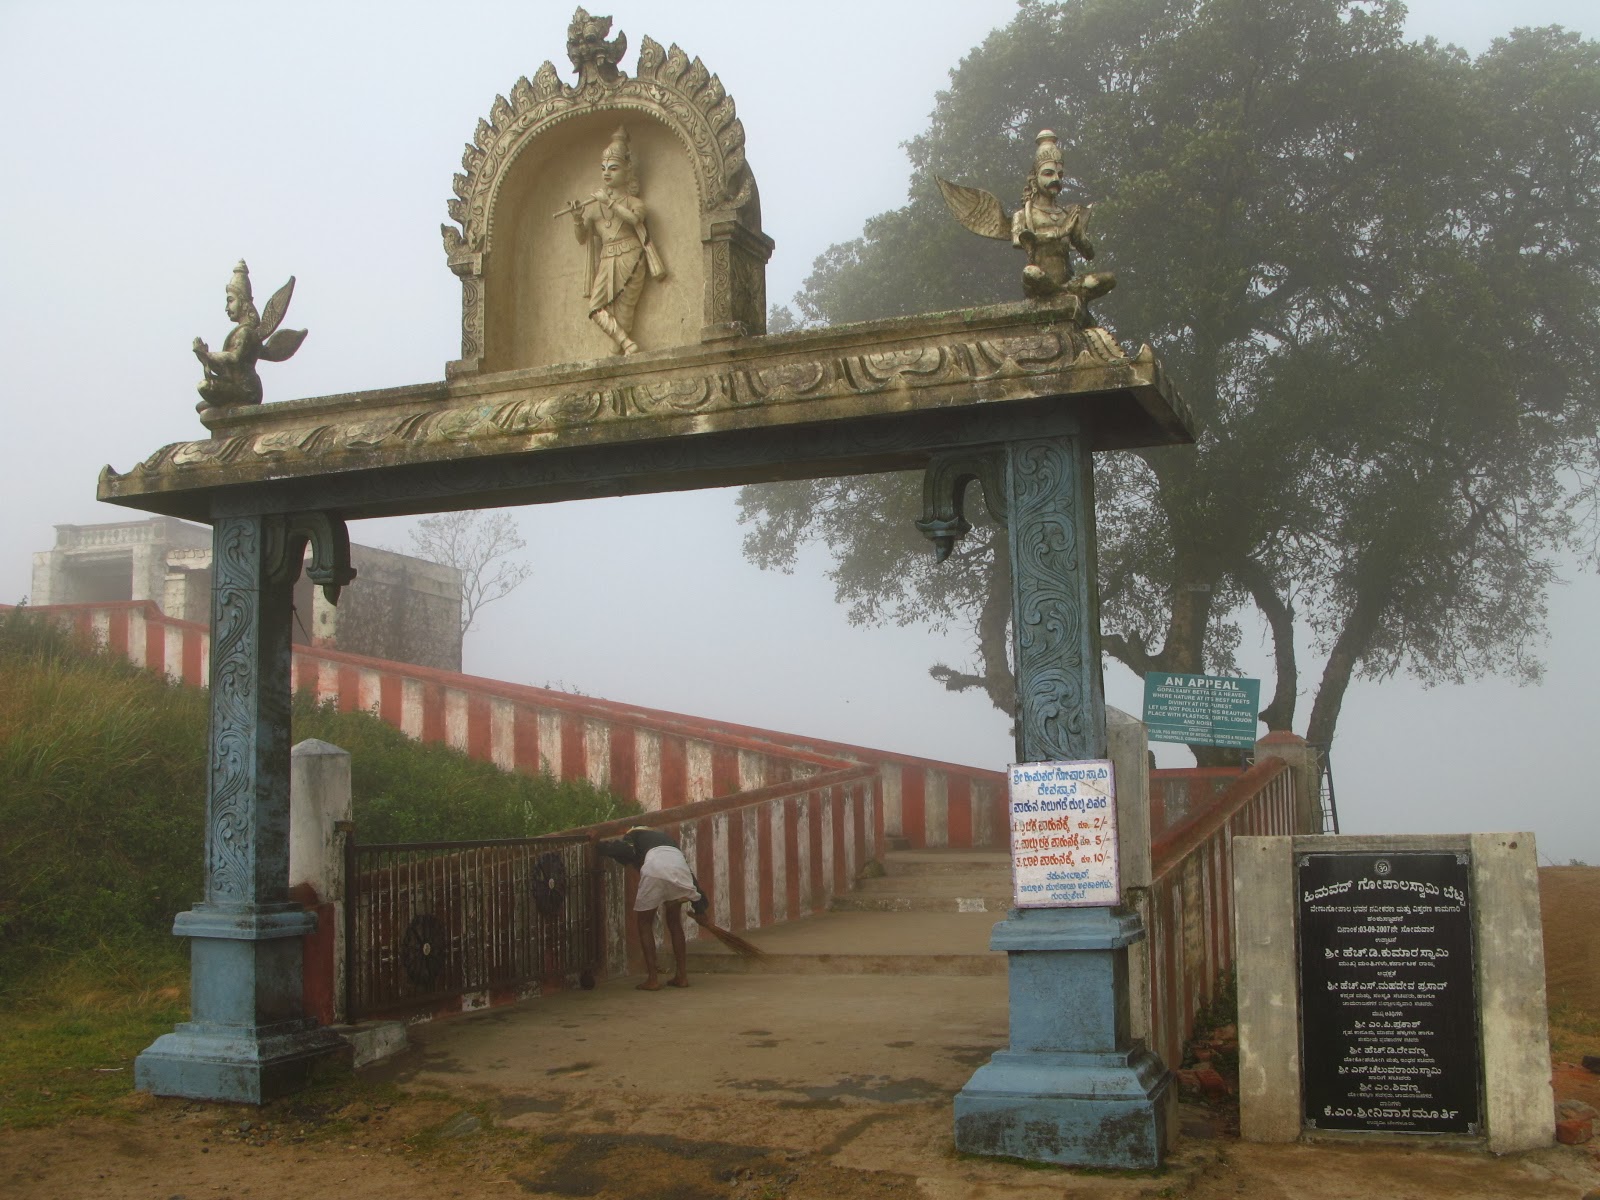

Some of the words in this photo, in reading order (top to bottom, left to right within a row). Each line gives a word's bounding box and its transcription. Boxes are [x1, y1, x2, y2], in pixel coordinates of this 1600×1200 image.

[1165, 677, 1183, 686] AN
[1188, 678, 1239, 690] APPEAL
[1014, 800, 1039, 813] ವಾಹನ
[1086, 797, 1107, 808] ವಿವರ
[1304, 880, 1353, 903] ಹಿಮವದ್
[1358, 878, 1440, 898] ಗೋಪಾಲಸ್ವಾಮಿ
[1444, 886, 1466, 906] ಬೆಟ್ಟ
[1396, 906, 1412, 914] ಮತ್ತು
[1324, 947, 1340, 959] ಶ್ರೀ
[1327, 982, 1338, 991] ಶ್ರೀ
[1354, 1020, 1365, 1028] ಶ್ರೀ
[1349, 1046, 1362, 1054] ಶ್ರೀ
[1338, 1066, 1348, 1075] ಶ್ರೀ
[1359, 1083, 1372, 1091] ಶ್ರೀ
